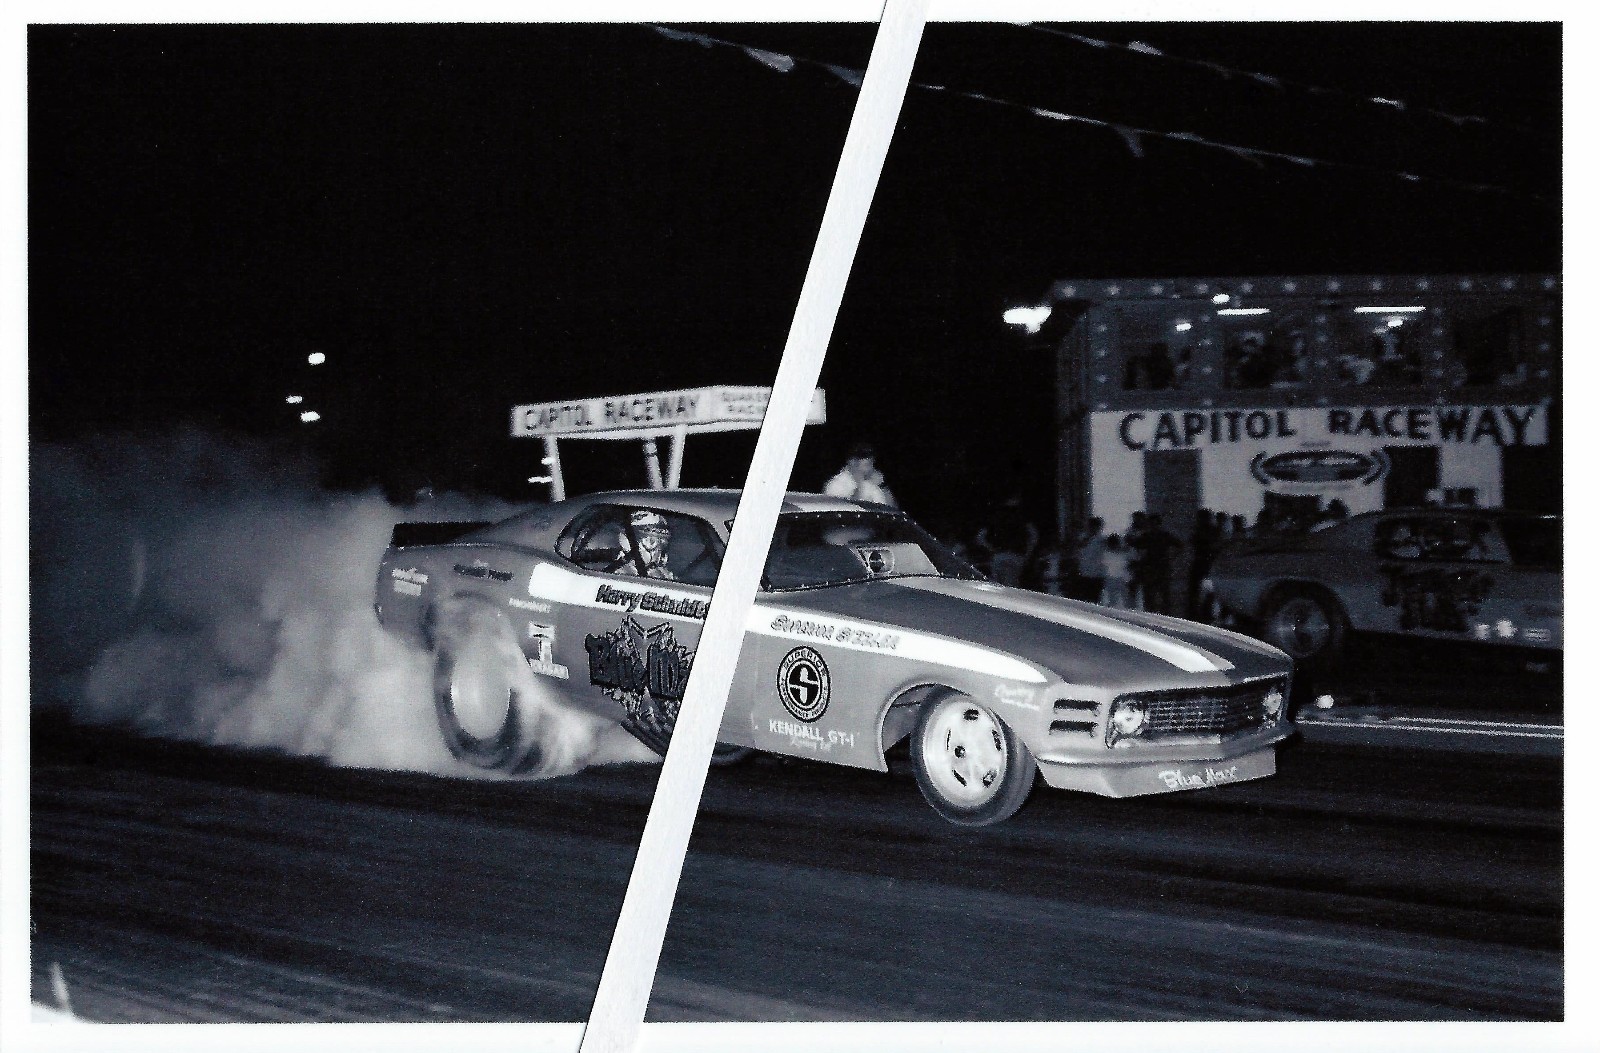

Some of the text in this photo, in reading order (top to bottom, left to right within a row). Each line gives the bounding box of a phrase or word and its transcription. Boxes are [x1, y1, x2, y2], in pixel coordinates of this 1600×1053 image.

[525, 395, 700, 431] CAPITOL RACEWAY
[1118, 408, 1535, 452] CAPITOL RACEWAY
[768, 718, 825, 742] KENDALL
[1158, 768, 1207, 790] Blue
